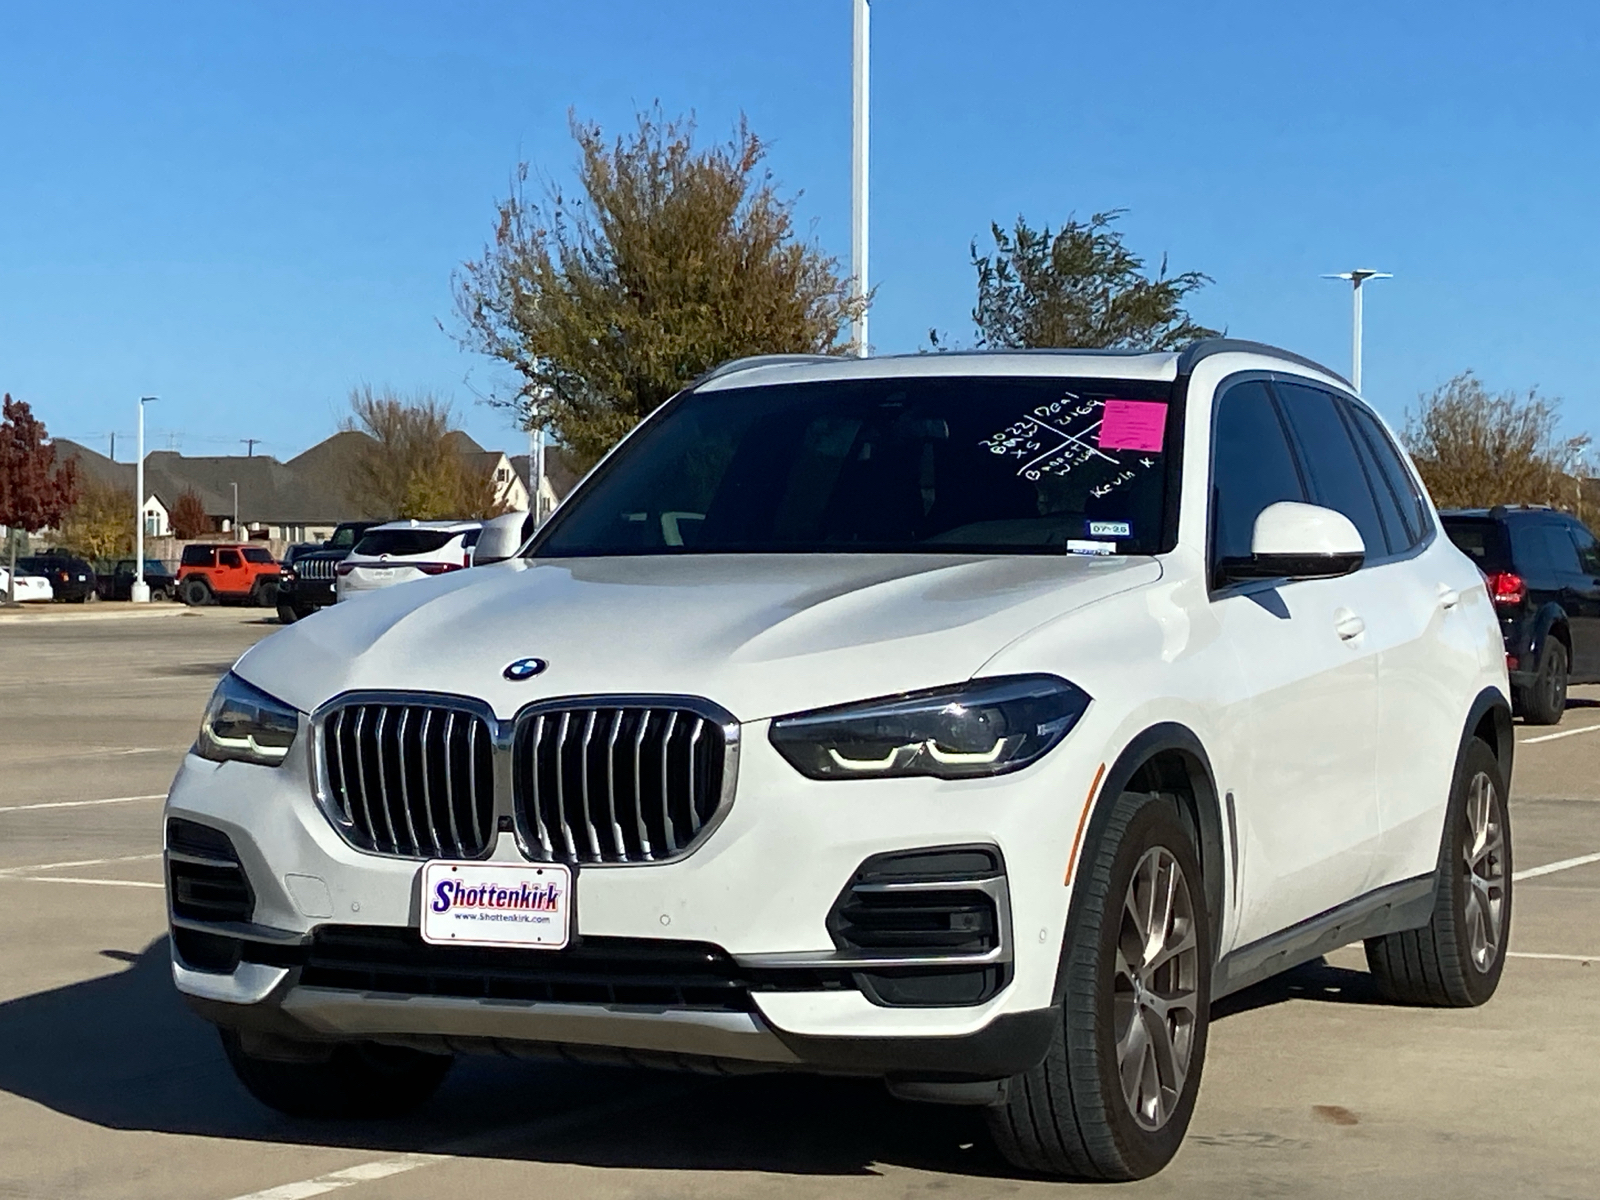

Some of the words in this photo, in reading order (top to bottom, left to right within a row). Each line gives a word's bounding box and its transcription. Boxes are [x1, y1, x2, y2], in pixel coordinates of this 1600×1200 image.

[978, 421, 1035, 446] 2022
[990, 424, 1039, 455] BMW
[1090, 470, 1136, 499] Kevin
[432, 879, 560, 914] Shottenkirk
[454, 912, 551, 924] www.Shottenkirk.com
